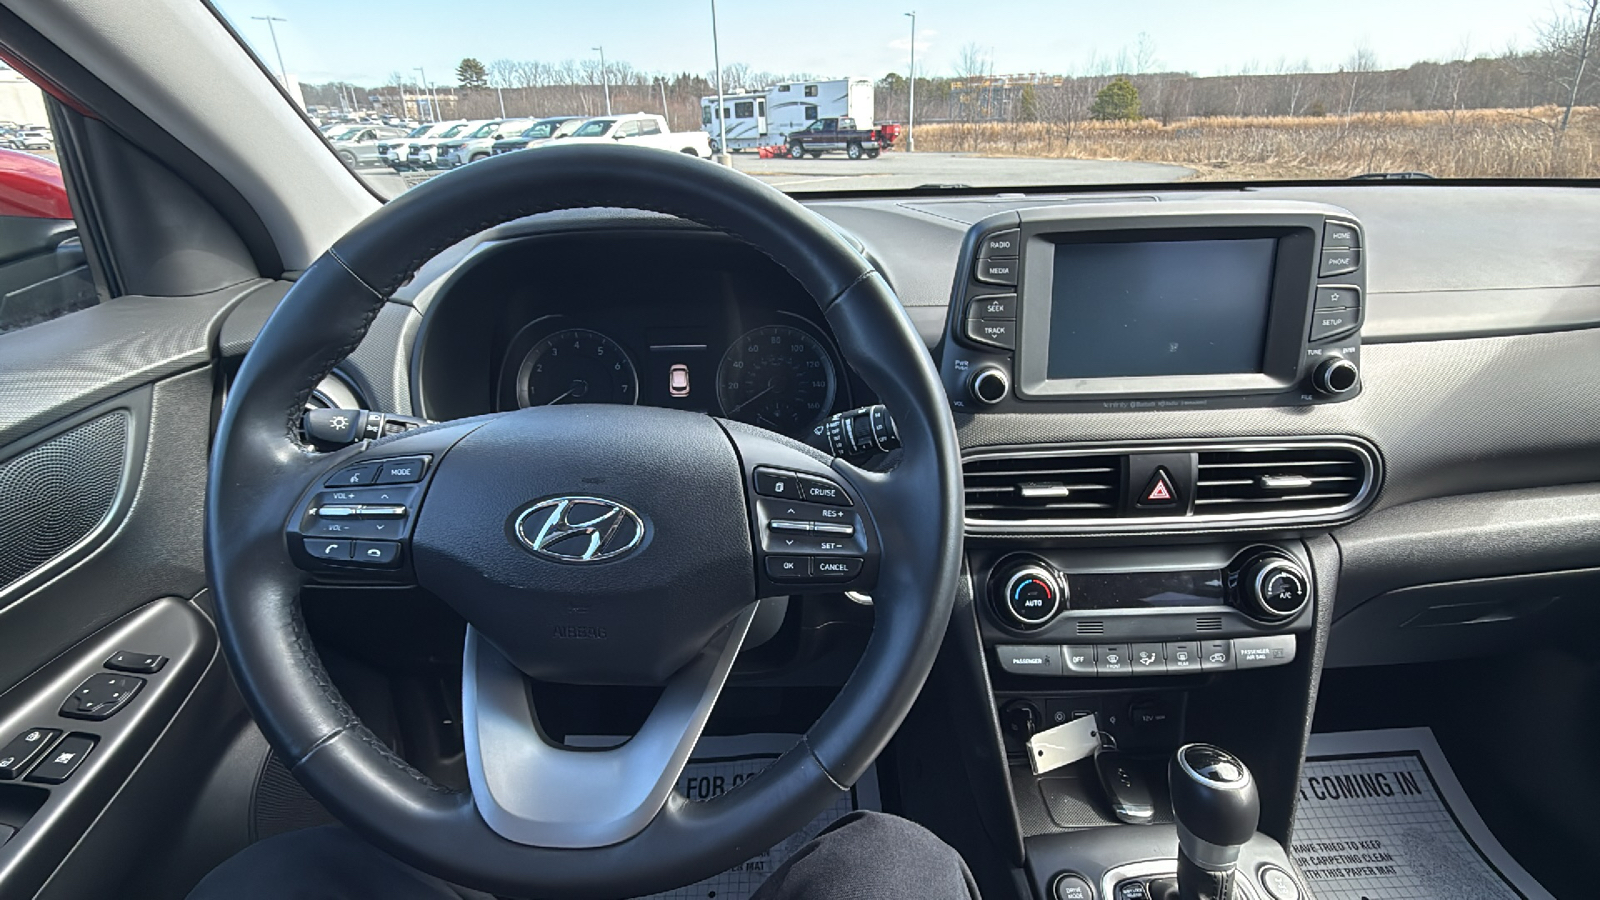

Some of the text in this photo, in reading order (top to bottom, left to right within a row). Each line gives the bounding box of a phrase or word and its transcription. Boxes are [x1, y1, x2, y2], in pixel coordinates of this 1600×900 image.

[1332, 231, 1351, 239] HOME
[990, 241, 1011, 249] RADIO
[1322, 318, 1342, 326] SETUP
[574, 341, 580, 349] 4
[791, 344, 804, 352] 100
[552, 348, 558, 356] 3
[597, 347, 604, 355] 5
[536, 365, 543, 373] 2
[614, 362, 621, 370] 6
[621, 385, 629, 393] 7
[391, 468, 411, 476] MODE
[809, 487, 836, 497] CRUISE
[820, 562, 849, 571] CANCEL
[1025, 599, 1043, 607] AUTO
[686, 775, 726, 800] FOR
[1308, 772, 1395, 801] COMING
[1393, 771, 1422, 796] IN
[1291, 839, 1382, 854] HAVE TRIED TO KEEP
[1310, 854, 1362, 866] CARPETING
[1362, 852, 1394, 863] CLEAN
[746, 861, 764, 872] MAT
[1303, 865, 1397, 879] ITH THIS PAPER MAT
